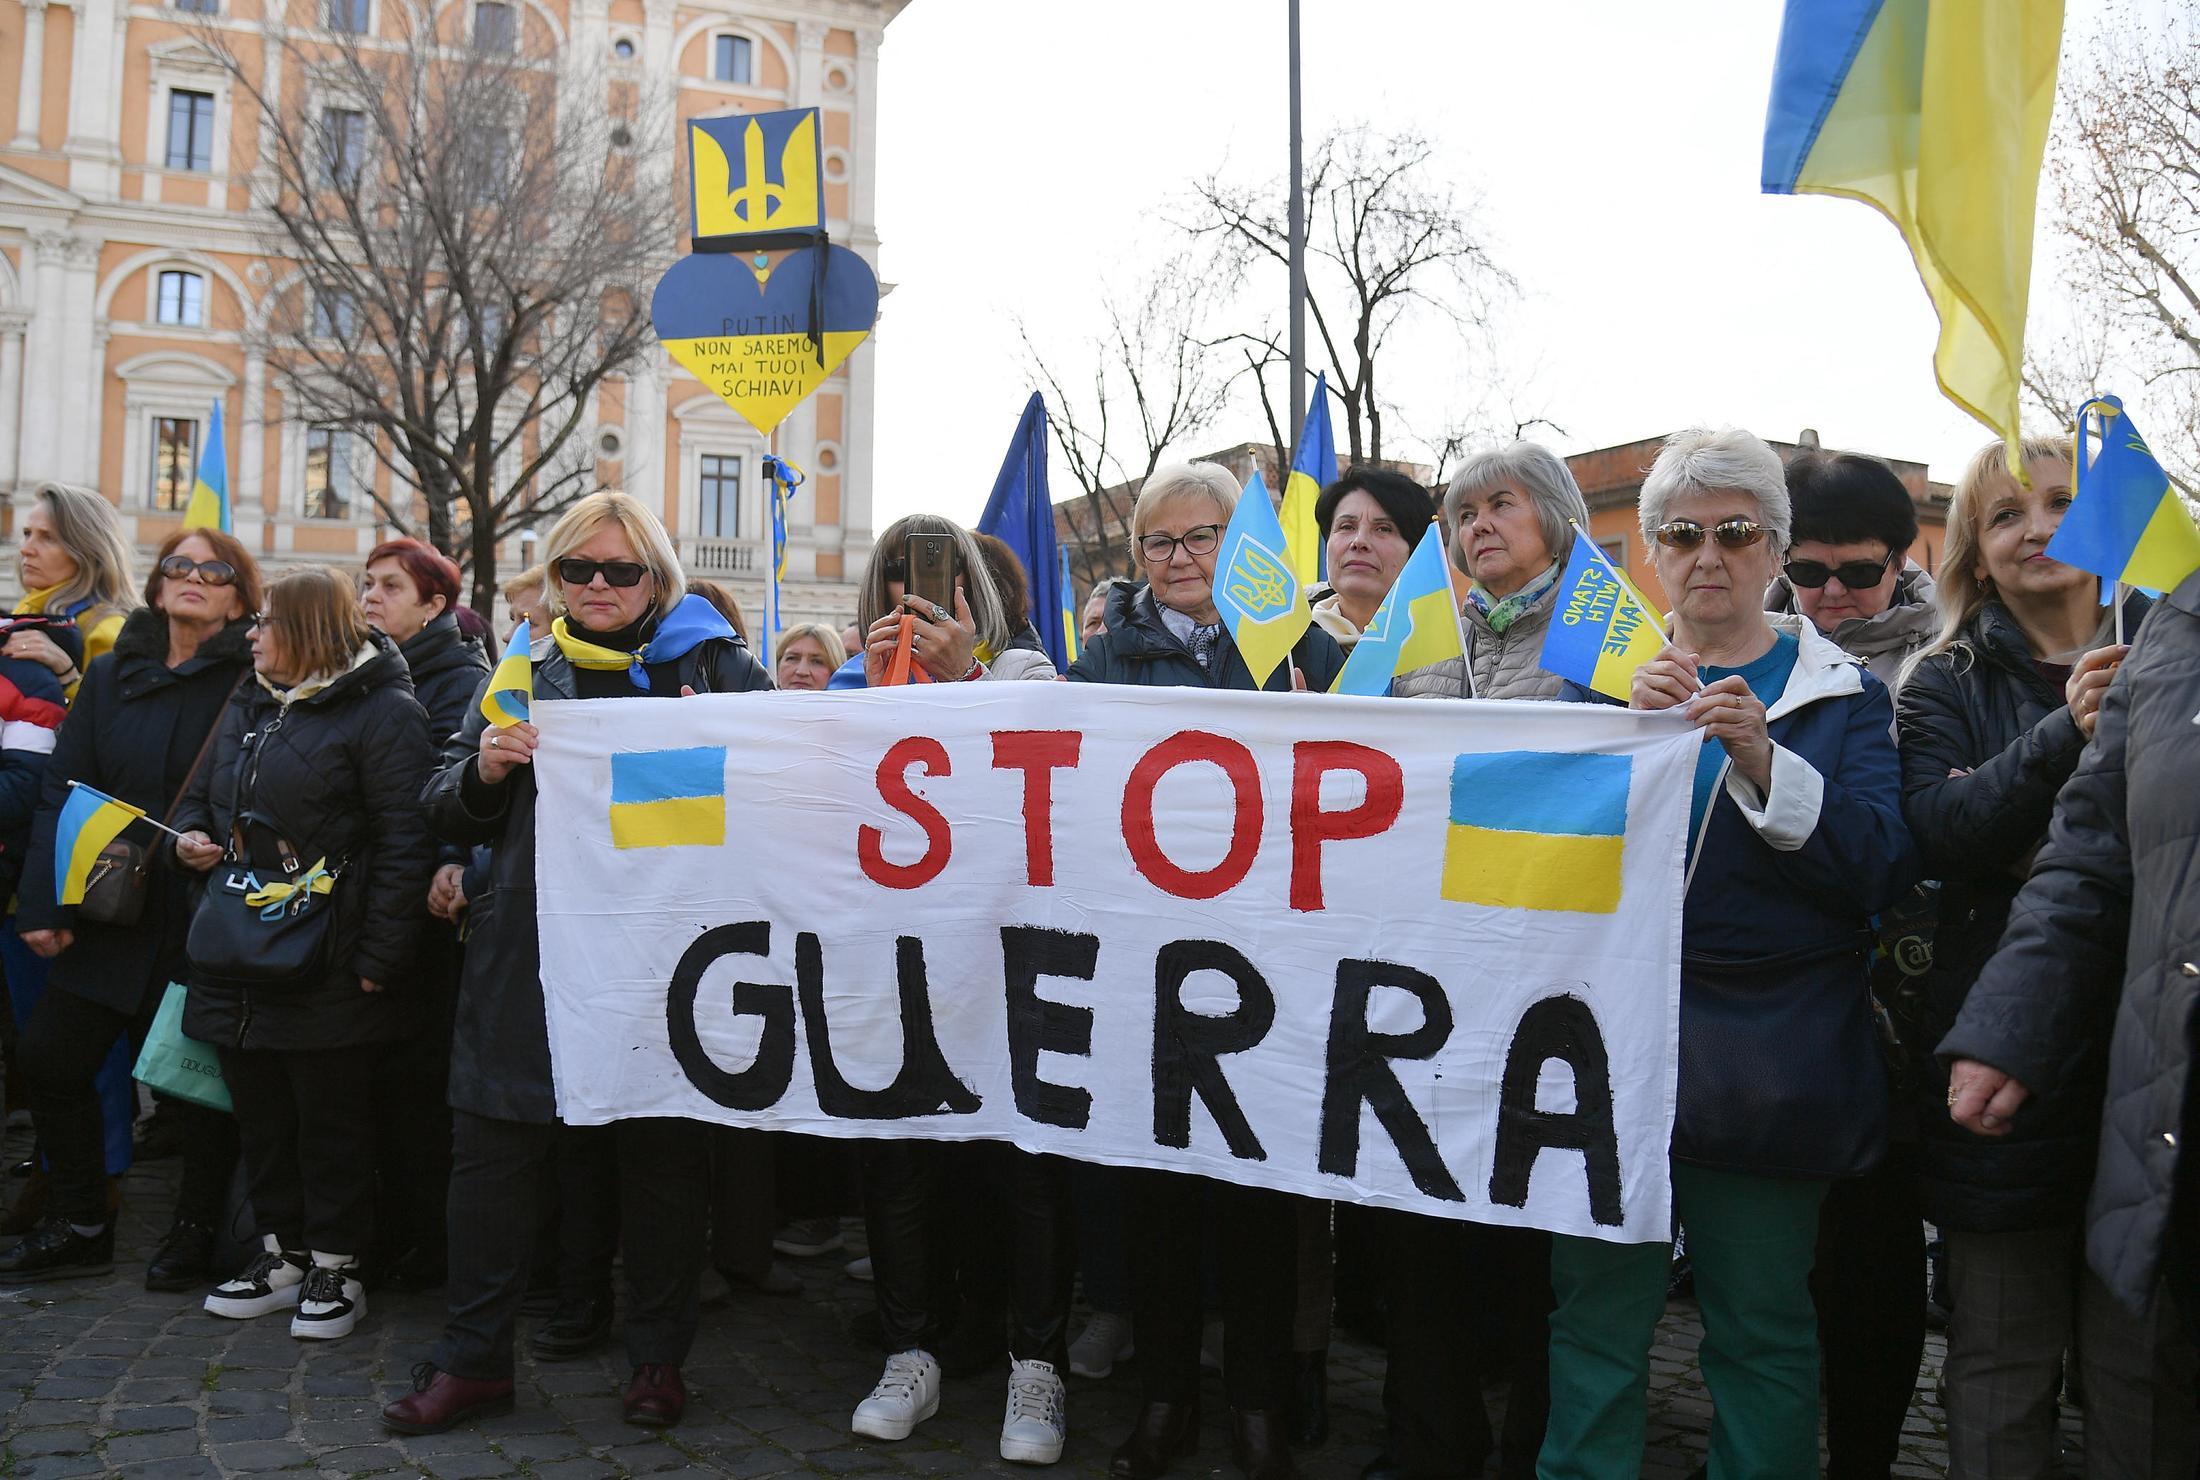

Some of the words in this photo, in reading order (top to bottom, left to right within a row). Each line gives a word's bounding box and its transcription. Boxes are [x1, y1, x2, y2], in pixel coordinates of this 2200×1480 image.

[694, 340, 731, 357] NON
[743, 338, 813, 356] SAREMO
[711, 361, 743, 374] MAI
[755, 360, 805, 375] TUOI
[722, 379, 803, 398] SCHIAVI
[858, 729, 1405, 913] STOP
[666, 920, 1625, 1227] GUERRA
